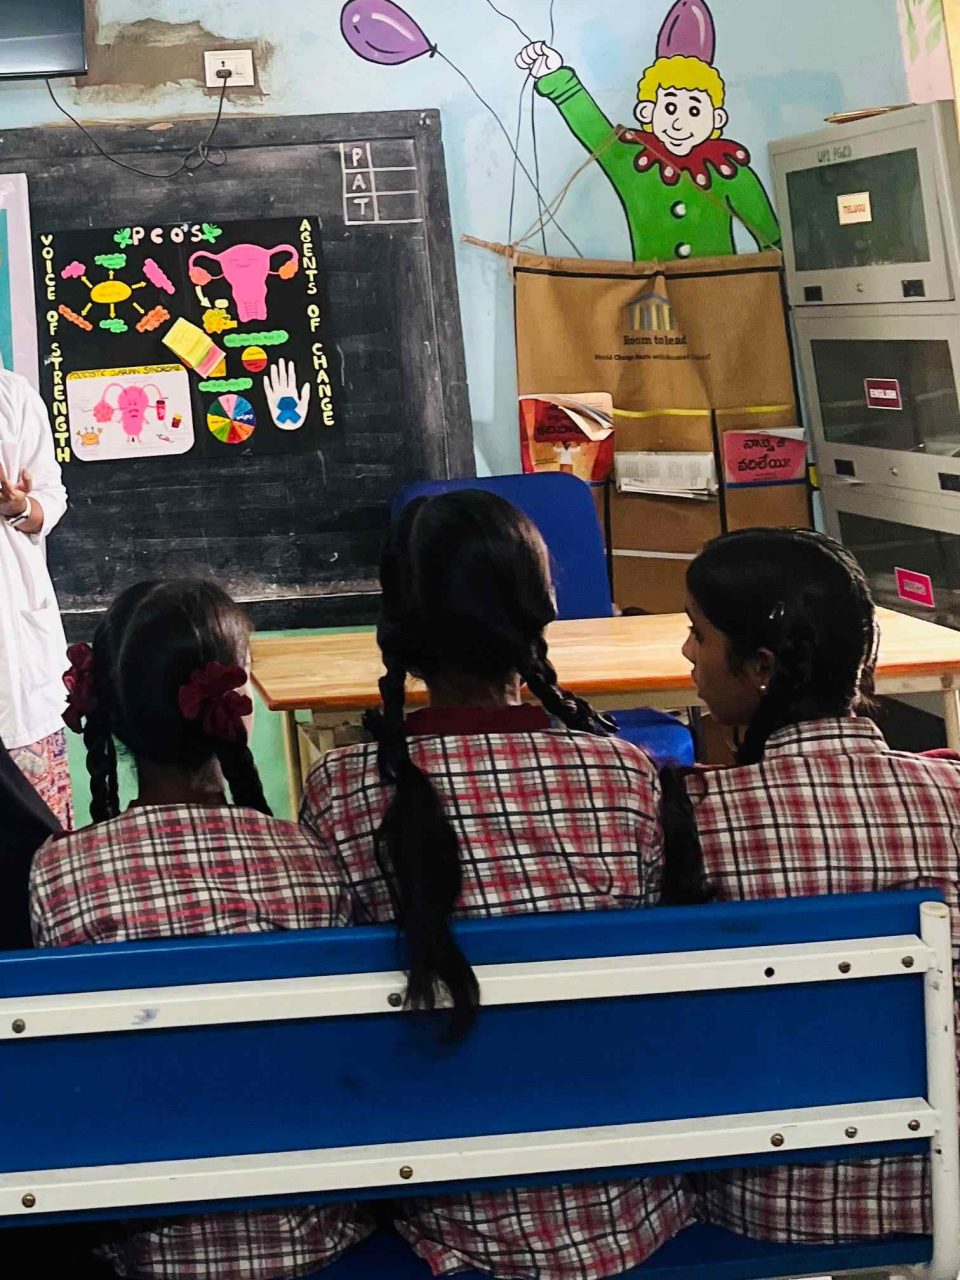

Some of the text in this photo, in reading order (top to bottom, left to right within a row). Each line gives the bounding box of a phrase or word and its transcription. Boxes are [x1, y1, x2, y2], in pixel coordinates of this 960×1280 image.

[352, 147, 363, 167] P
[352, 174, 366, 190] A
[353, 198, 370, 215] T
[299, 218, 335, 427] AGENTS OF CHANGE
[40, 234, 71, 463] VOICE OF STRENGTH
